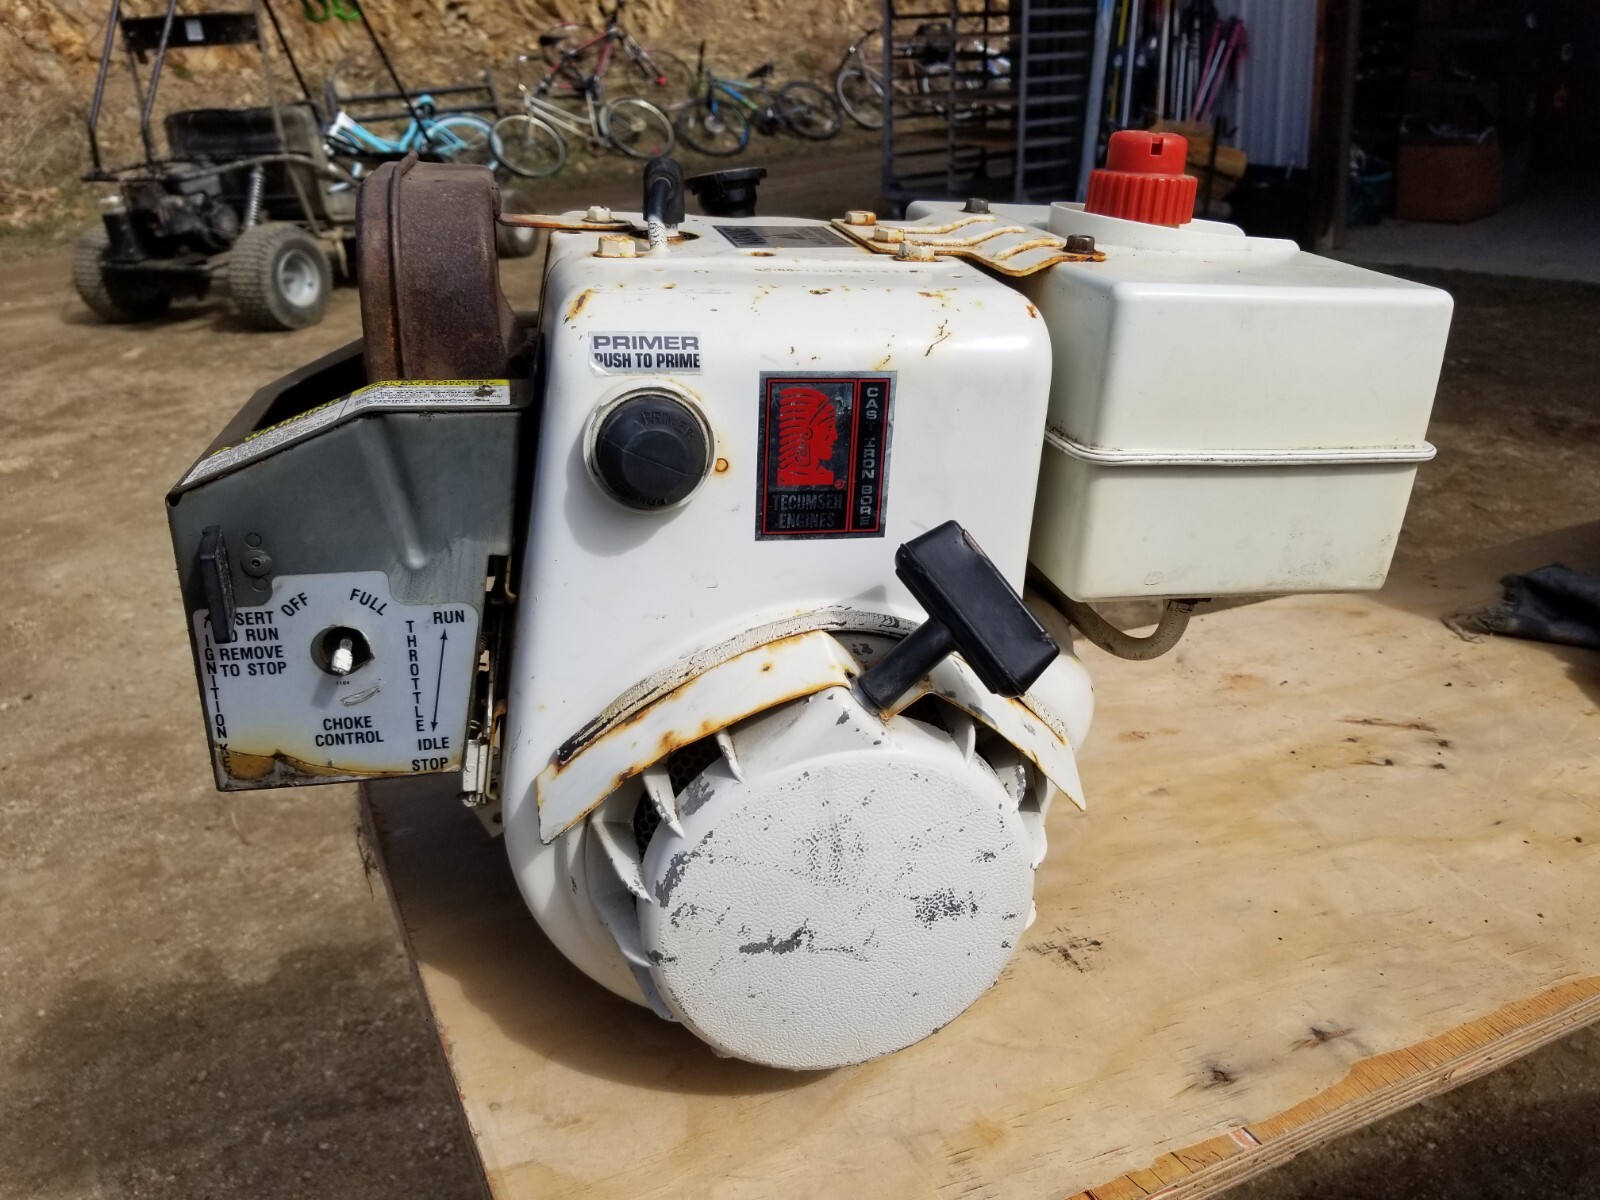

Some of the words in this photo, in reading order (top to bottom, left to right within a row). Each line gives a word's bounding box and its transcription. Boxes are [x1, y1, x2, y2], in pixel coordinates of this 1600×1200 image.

[593, 335, 699, 350] PRIMER
[594, 352, 632, 368] PUSH
[635, 352, 653, 368] TO
[656, 353, 700, 368] PRIME
[641, 409, 695, 439] PRIMER
[771, 493, 843, 511] TECUMSEH
[859, 484, 874, 526] BORE
[778, 512, 836, 529] ENGINES
[281, 592, 309, 617] OFF
[350, 588, 388, 617] FULL
[235, 610, 274, 626] SERT
[433, 610, 465, 625] RUN
[245, 627, 279, 642] RUN
[219, 645, 284, 661] REMOVE
[219, 663, 241, 677] TO
[247, 661, 287, 676] STOP
[405, 620, 425, 732] THROTTLE
[204, 634, 228, 739] IGNITION
[323, 716, 373, 731] CHOKE
[315, 731, 385, 747] CONTROL
[418, 737, 450, 751] IDLE
[412, 757, 449, 772] STOP
